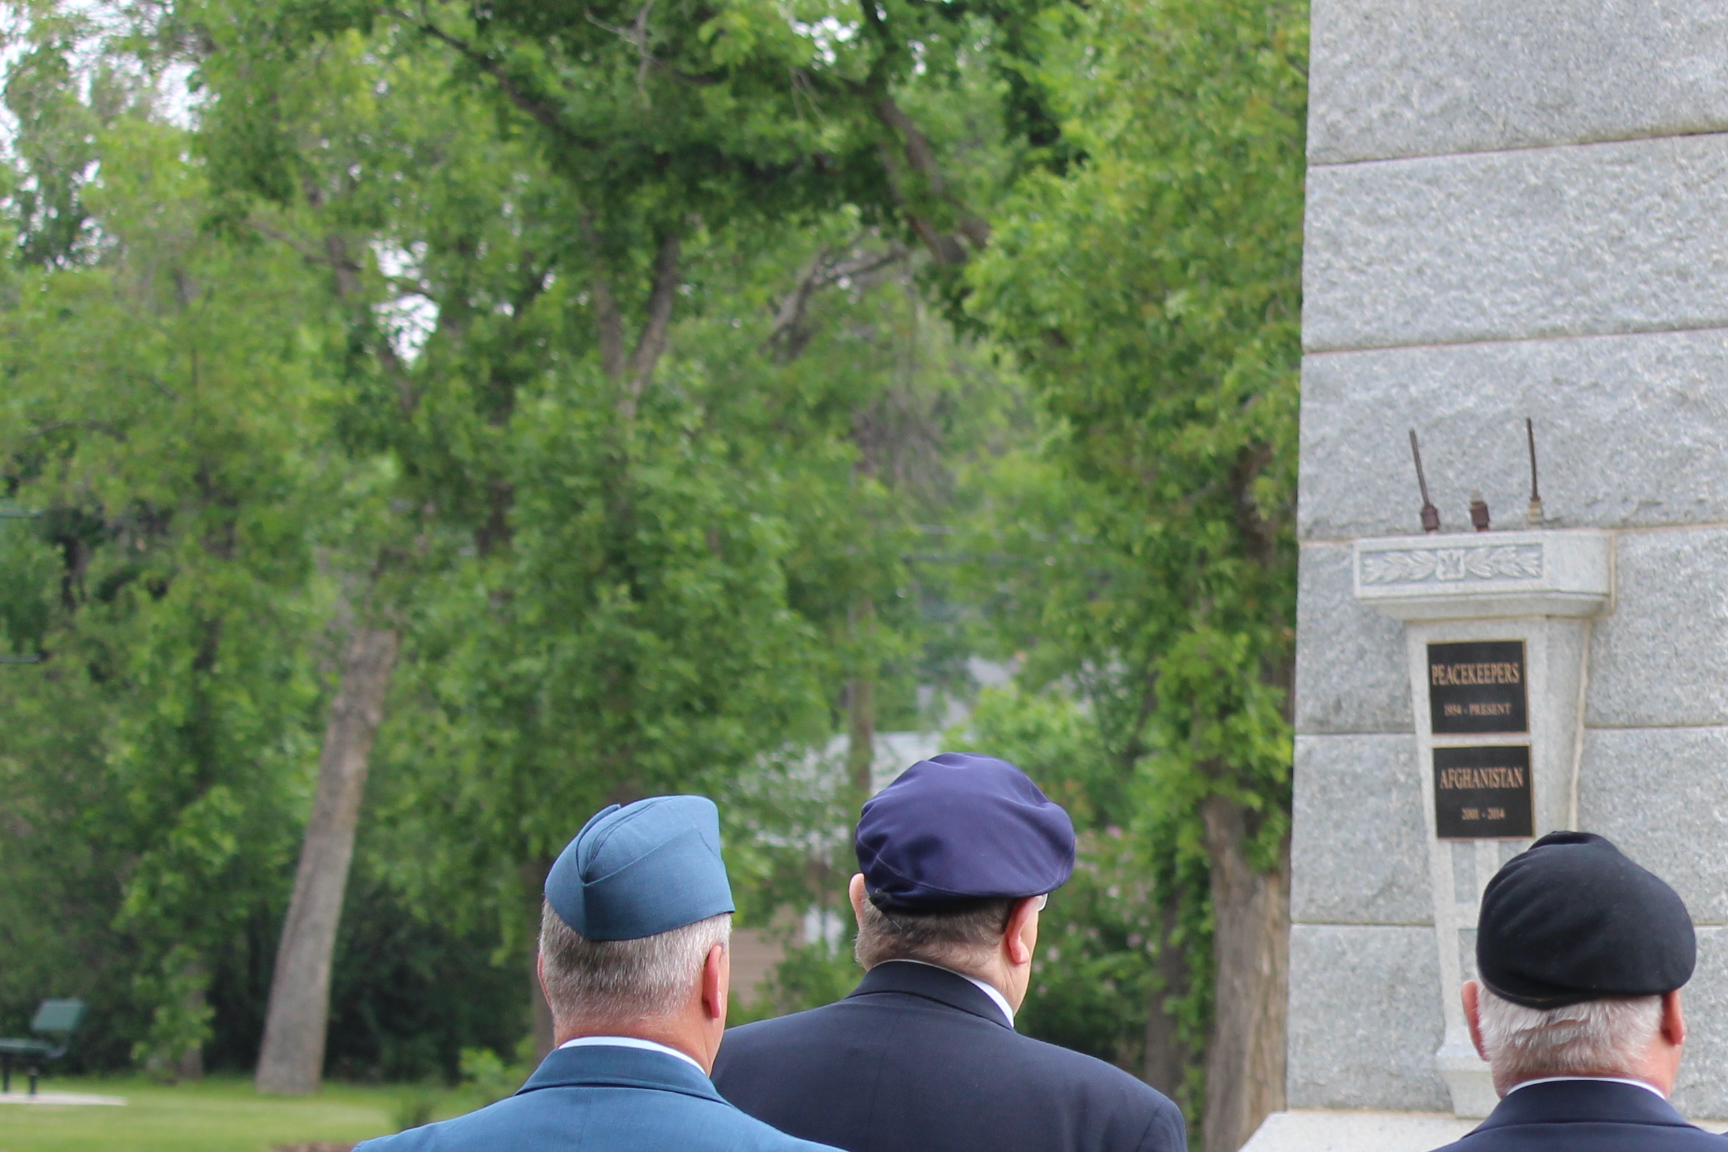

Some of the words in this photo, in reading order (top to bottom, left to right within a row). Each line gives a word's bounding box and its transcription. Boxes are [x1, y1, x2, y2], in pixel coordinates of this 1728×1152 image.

[1431, 662, 1519, 685] PEACEKEEPERS
[1468, 702, 1511, 716] PRESENT
[1439, 766, 1524, 790] AFGHANISTAN
